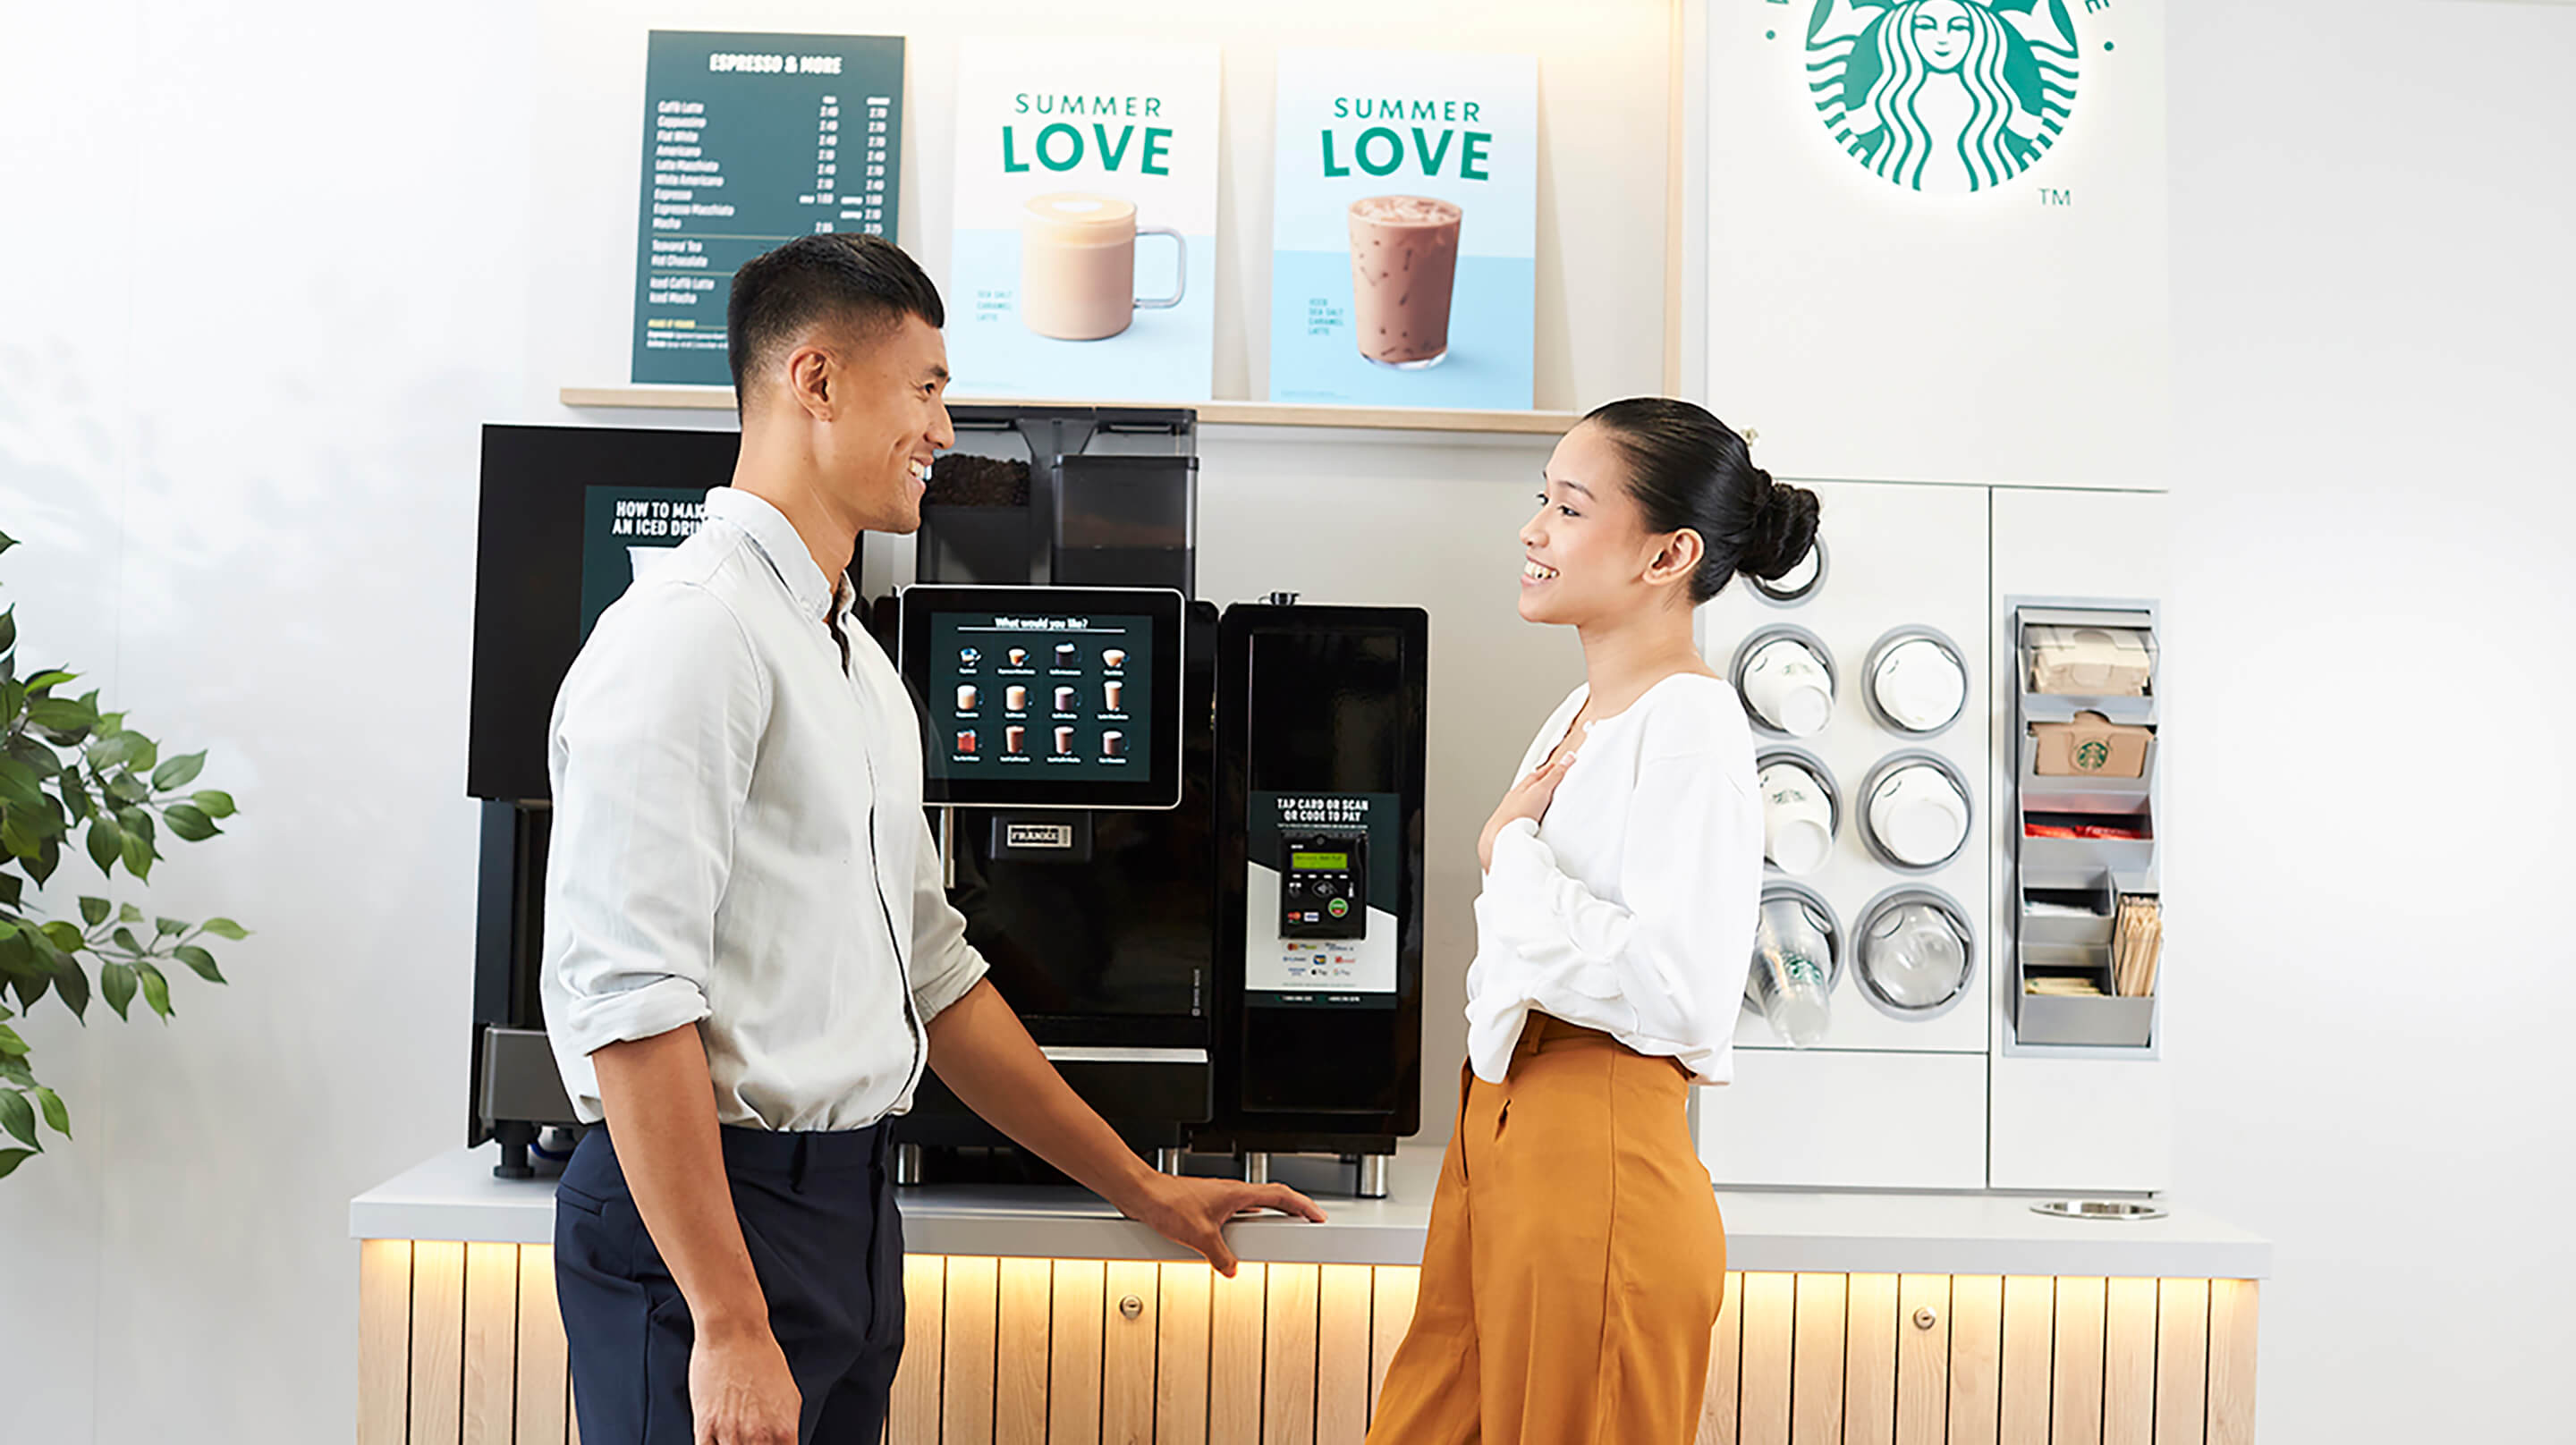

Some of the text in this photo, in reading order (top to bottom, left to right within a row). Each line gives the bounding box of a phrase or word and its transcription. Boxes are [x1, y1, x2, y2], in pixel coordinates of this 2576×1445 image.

[709, 54, 842, 74] ESPRESSO & MORE
[1014, 92, 1162, 117] SUMMER
[1334, 97, 1479, 123] SUMMER
[1003, 122, 1173, 176] LOVE
[1321, 127, 1492, 181] LOVE
[2038, 188, 2072, 206] TM
[615, 501, 705, 519] HOW TO MAK
[612, 519, 633, 535] AN
[636, 520, 668, 536] ICED
[1276, 798, 1368, 811] TAP CARD OR SCAN
[1300, 810, 1326, 822] CODE
[1328, 811, 1340, 822] TO
[1342, 811, 1361, 822] PAY
